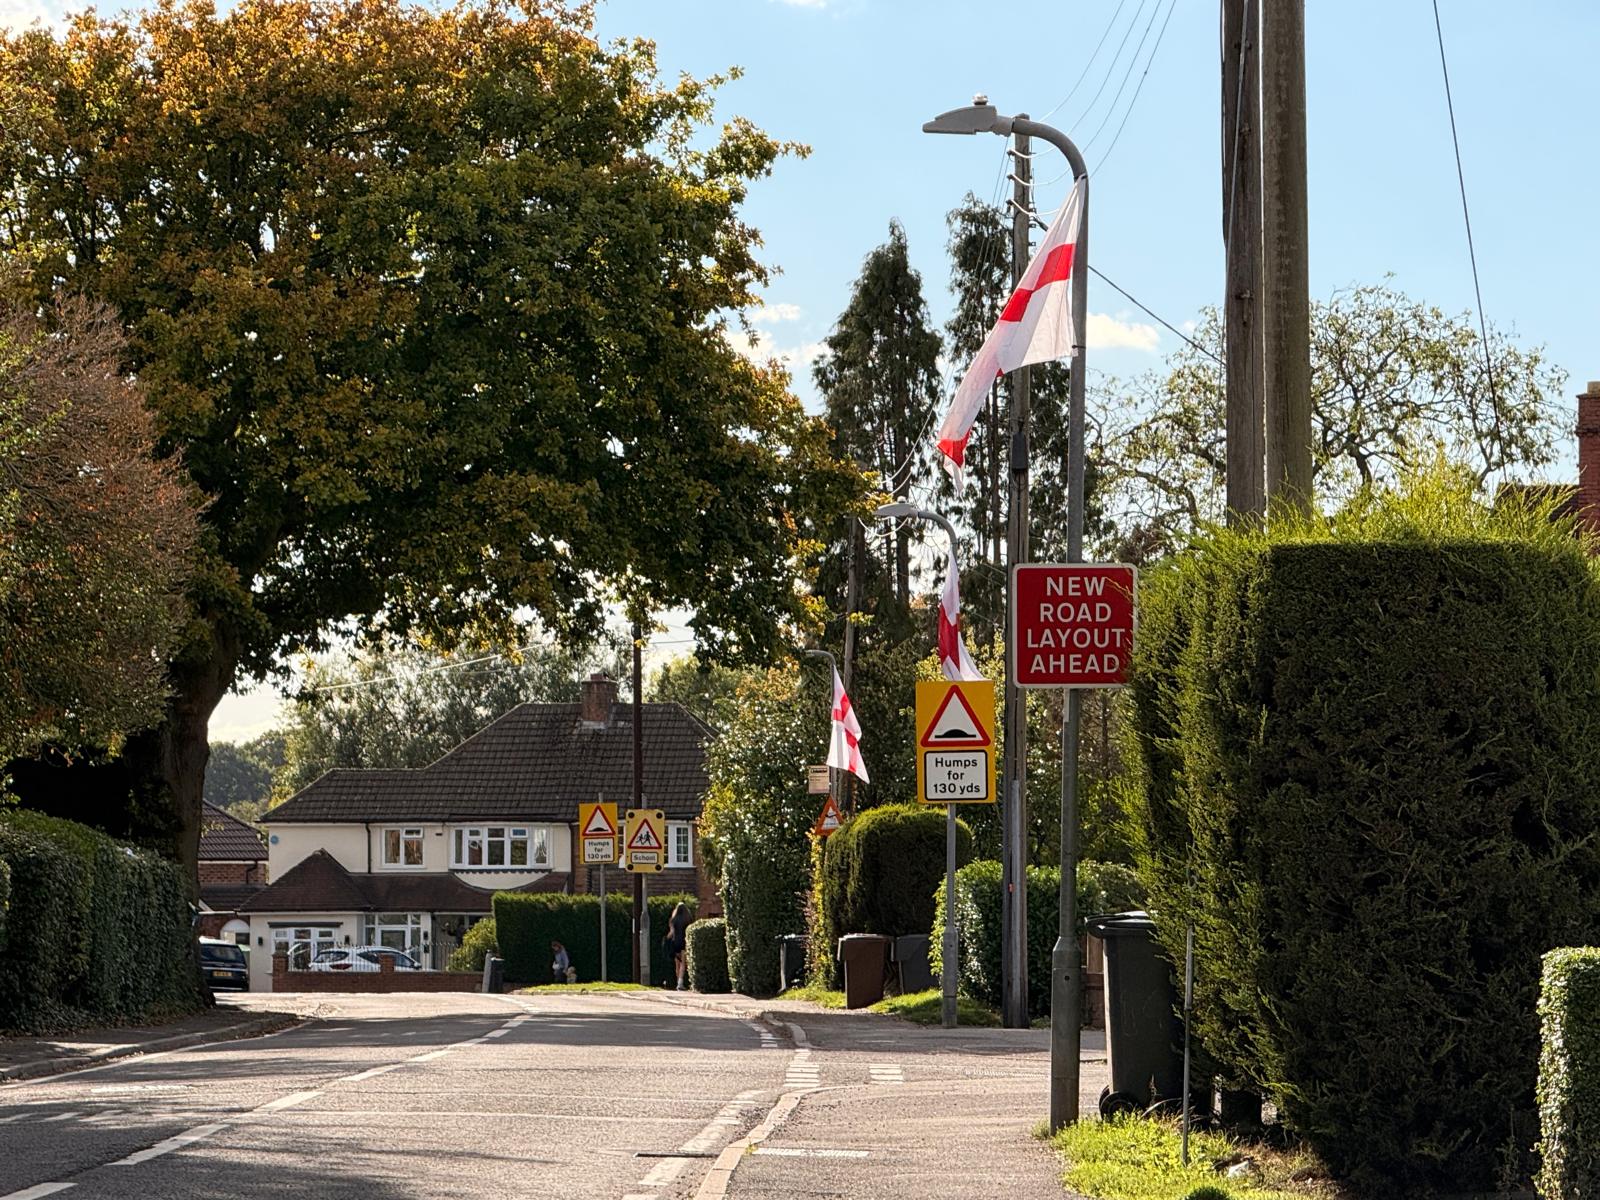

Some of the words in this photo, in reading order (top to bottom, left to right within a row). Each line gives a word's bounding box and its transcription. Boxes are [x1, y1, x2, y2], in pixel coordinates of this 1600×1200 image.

[1046, 576, 1106, 596] NEW
[1040, 603, 1112, 622] ROAD
[1027, 628, 1125, 648] LAYOUT
[1030, 654, 1120, 674] AHEAD
[935, 757, 978, 769] Humps
[947, 770, 965, 780] for
[933, 783, 957, 793] 130
[959, 783, 980, 795] yds
